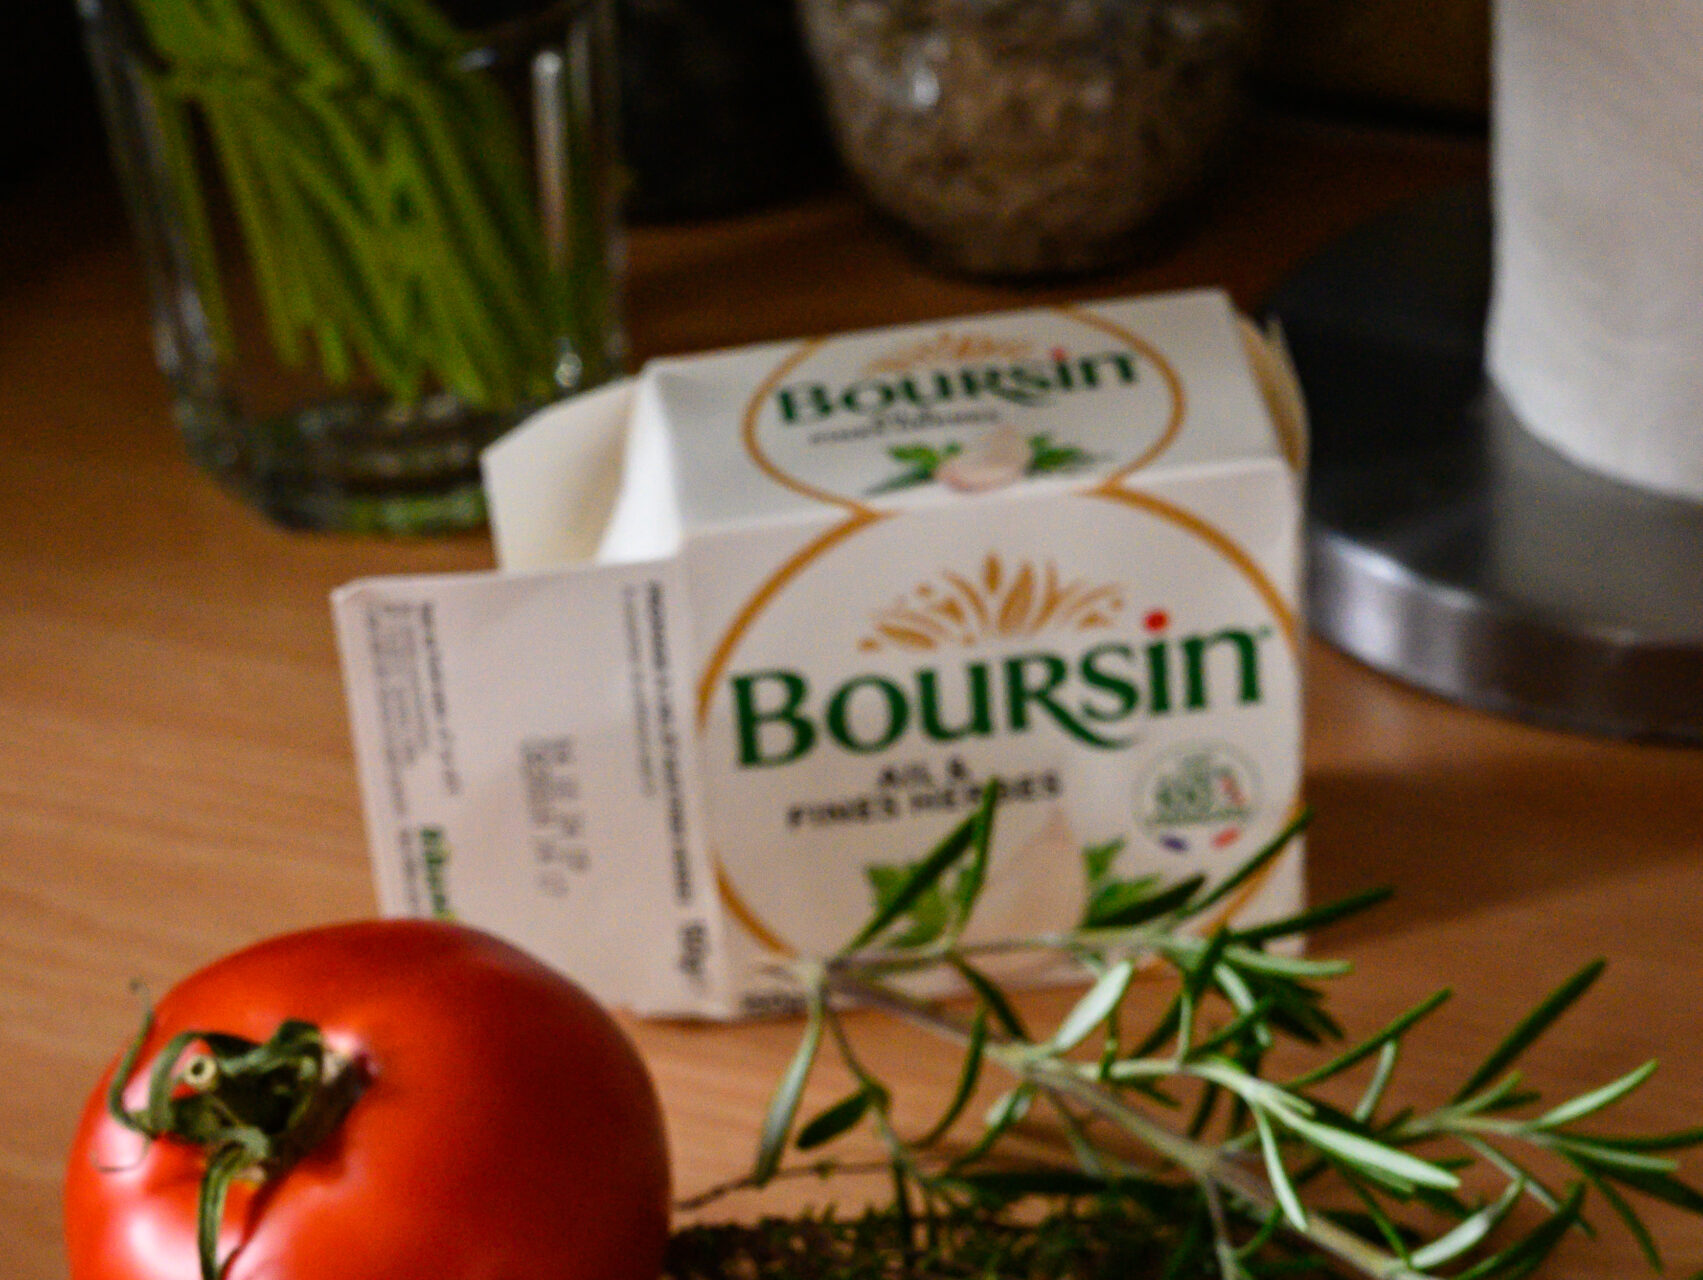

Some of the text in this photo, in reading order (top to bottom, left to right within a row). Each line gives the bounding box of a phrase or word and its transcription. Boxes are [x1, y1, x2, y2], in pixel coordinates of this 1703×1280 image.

[879, 755, 969, 791] AIL &
[786, 795, 900, 827] FINES
